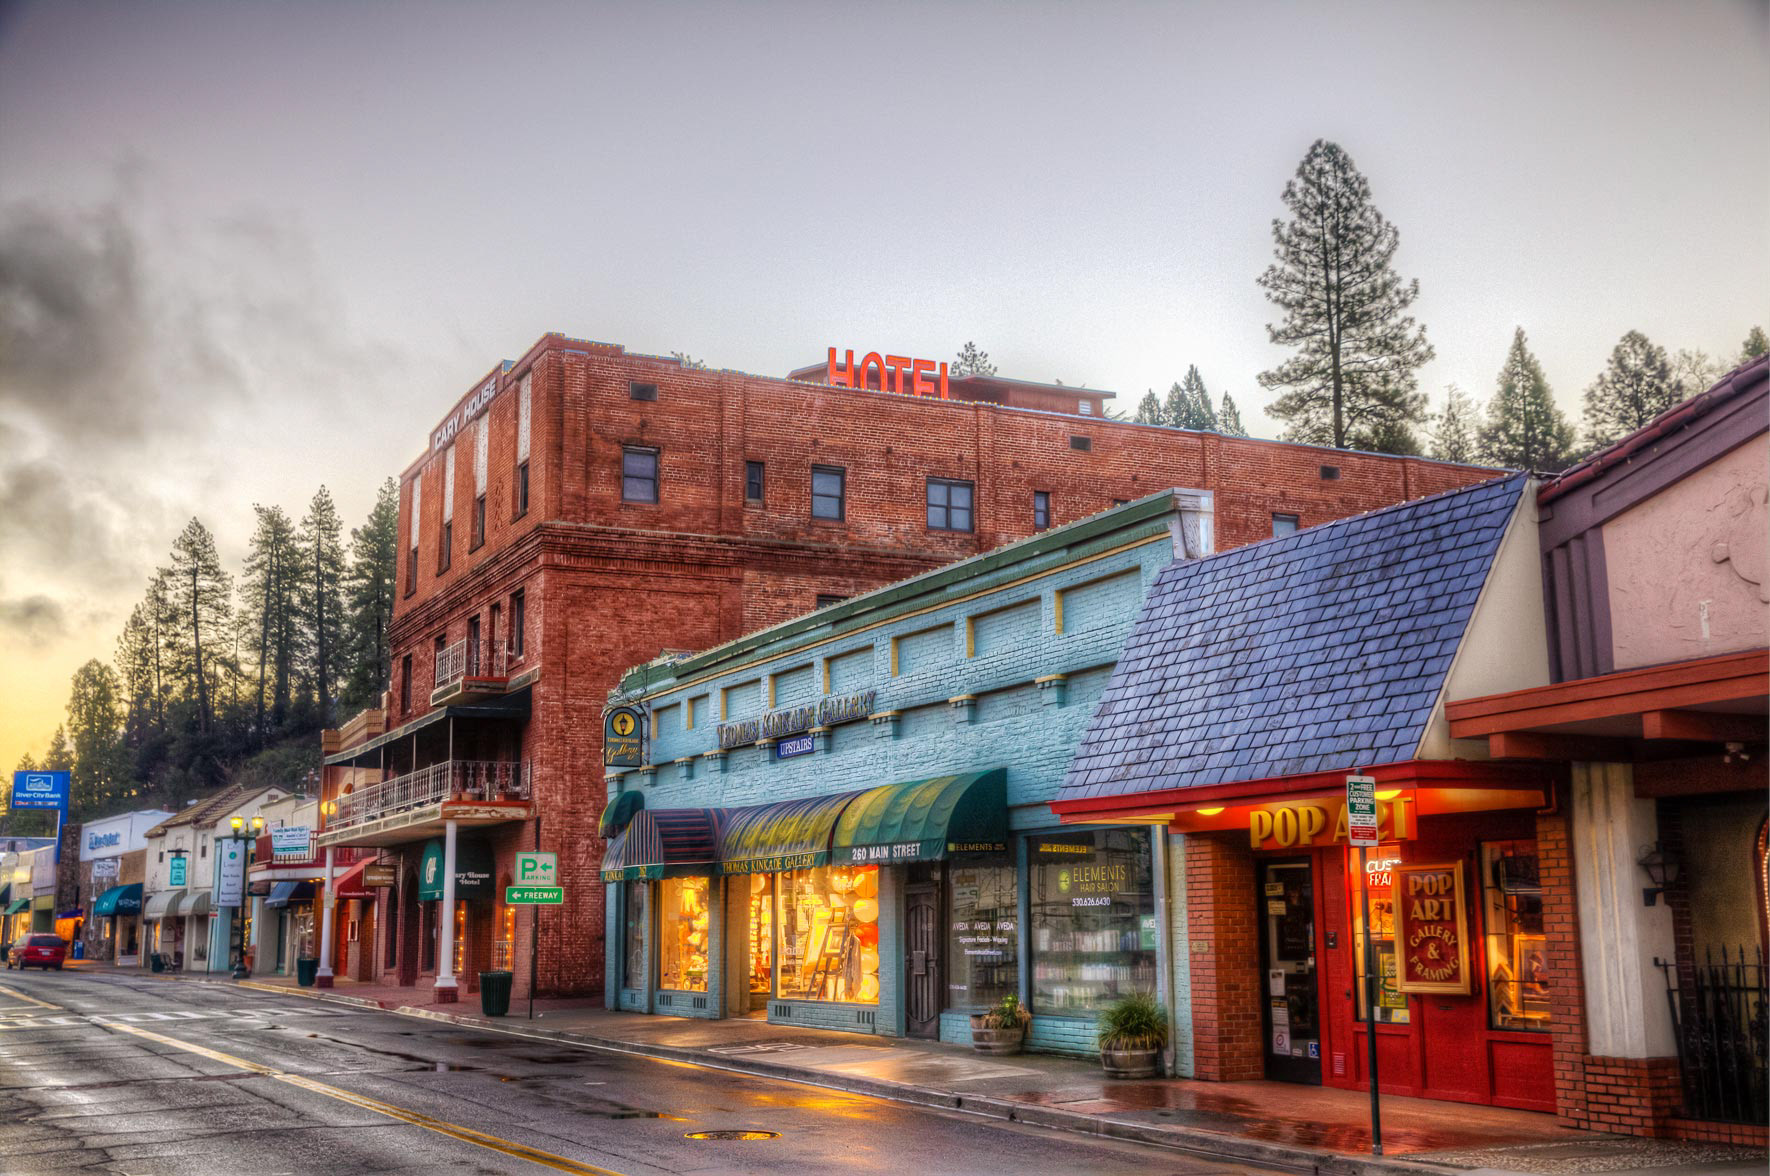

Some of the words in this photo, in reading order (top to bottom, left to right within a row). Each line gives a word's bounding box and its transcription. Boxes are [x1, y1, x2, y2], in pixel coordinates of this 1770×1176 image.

[434, 412, 460, 450] CARY
[463, 377, 497, 423] HOUSE
[717, 719, 759, 747] THOMAS
[762, 704, 815, 739] KINKADE
[817, 689, 877, 725] GALLERY
[780, 737, 812, 755] UPSTAIRS
[1250, 806, 1326, 849] POP
[852, 847, 867, 861] 260
[869, 846, 889, 859] MAIN
[892, 843, 921, 858] STREET
[956, 843, 993, 851] ELEMENTS
[521, 857, 551, 881] PARKING
[723, 861, 749, 873] THOMAS
[751, 858, 782, 871] KINKADE
[785, 853, 815, 869] GALLERY
[466, 871, 490, 879] House
[1073, 864, 1127, 883] ELEMENTS
[1080, 882, 1096, 893] HAIR
[1097, 882, 1120, 892] SALON
[1408, 874, 1453, 896] POP
[523, 891, 559, 900] FREEWAY
[1410, 898, 1454, 921] ART
[952, 921, 969, 931] AVEDA
[974, 921, 991, 931] AVEDA
[996, 921, 1014, 931] AVEDA
[1142, 919, 1156, 929] AVE
[1409, 924, 1457, 948] GALLERY
[1427, 942, 1440, 960] &
[1409, 955, 1460, 981] FRAMING
